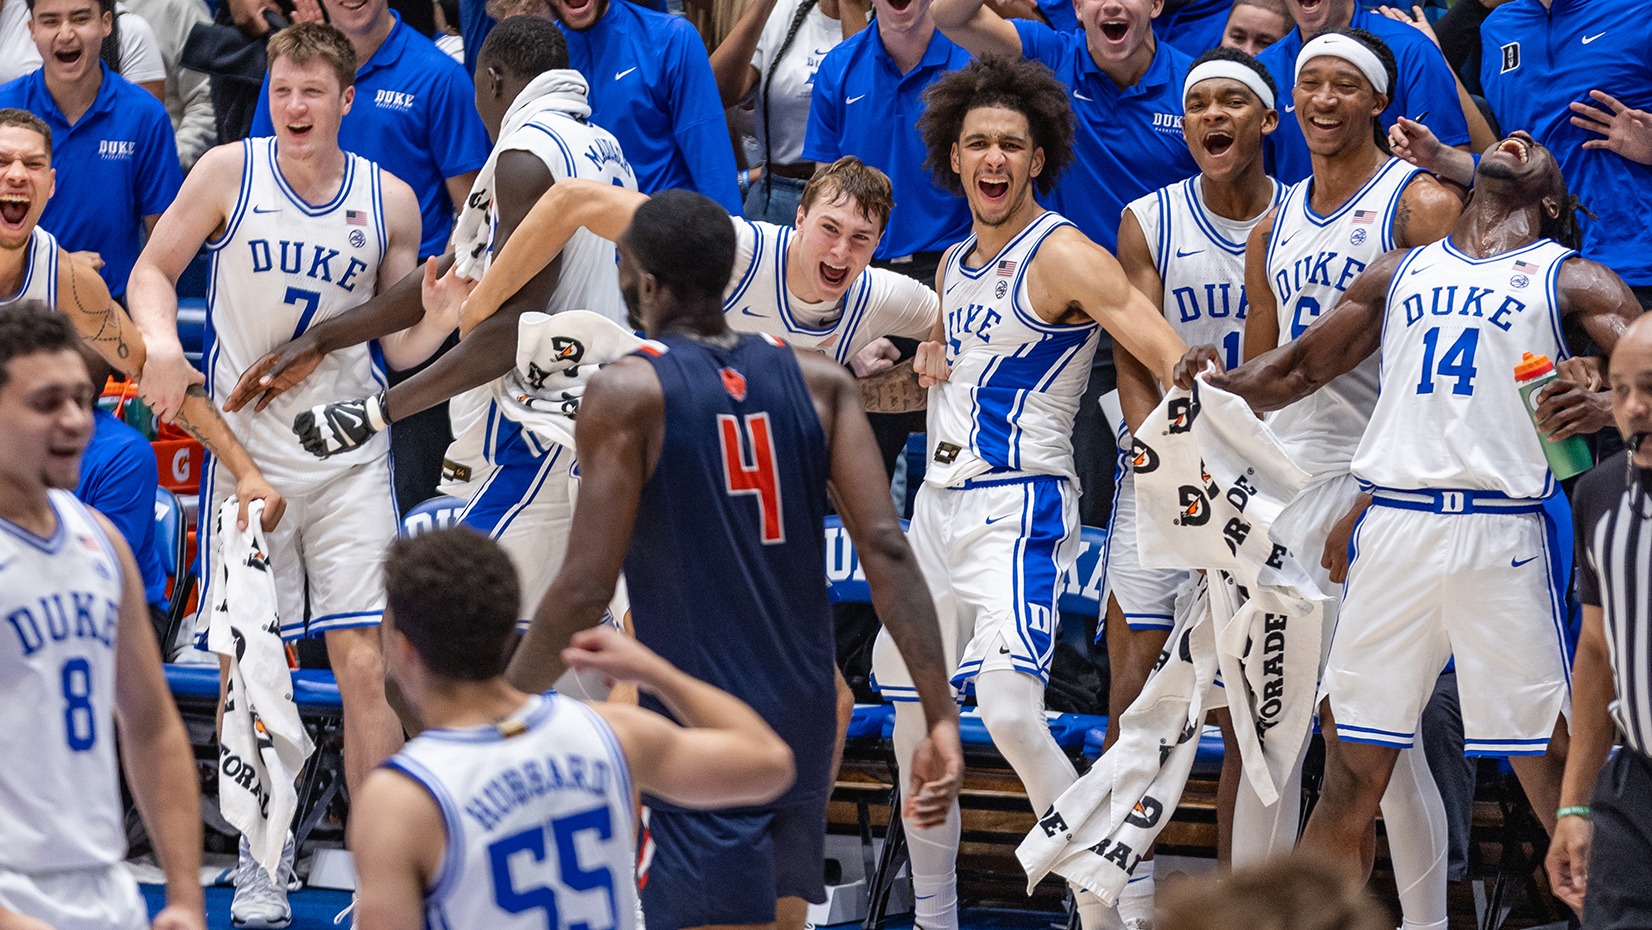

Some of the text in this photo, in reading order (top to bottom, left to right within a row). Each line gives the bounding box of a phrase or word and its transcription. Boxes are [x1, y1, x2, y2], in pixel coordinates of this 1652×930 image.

[374, 89, 415, 108] DUKE
[1152, 112, 1185, 128] DUK
[98, 140, 136, 155] DUKE
[248, 239, 368, 292] DUKE
[1276, 251, 1366, 306] DUKE
[283, 286, 321, 342] 7
[948, 304, 1002, 343] UKE
[1403, 285, 1526, 332] DUKE
[1223, 331, 1240, 371] 1
[1416, 326, 1480, 396] 14
[172, 447, 191, 483] G
[716, 411, 785, 546] 4
[1441, 491, 1464, 512] D
[7, 592, 118, 656] DUKE
[1027, 602, 1050, 634] D
[62, 658, 96, 751] 8
[487, 804, 618, 930] 55
